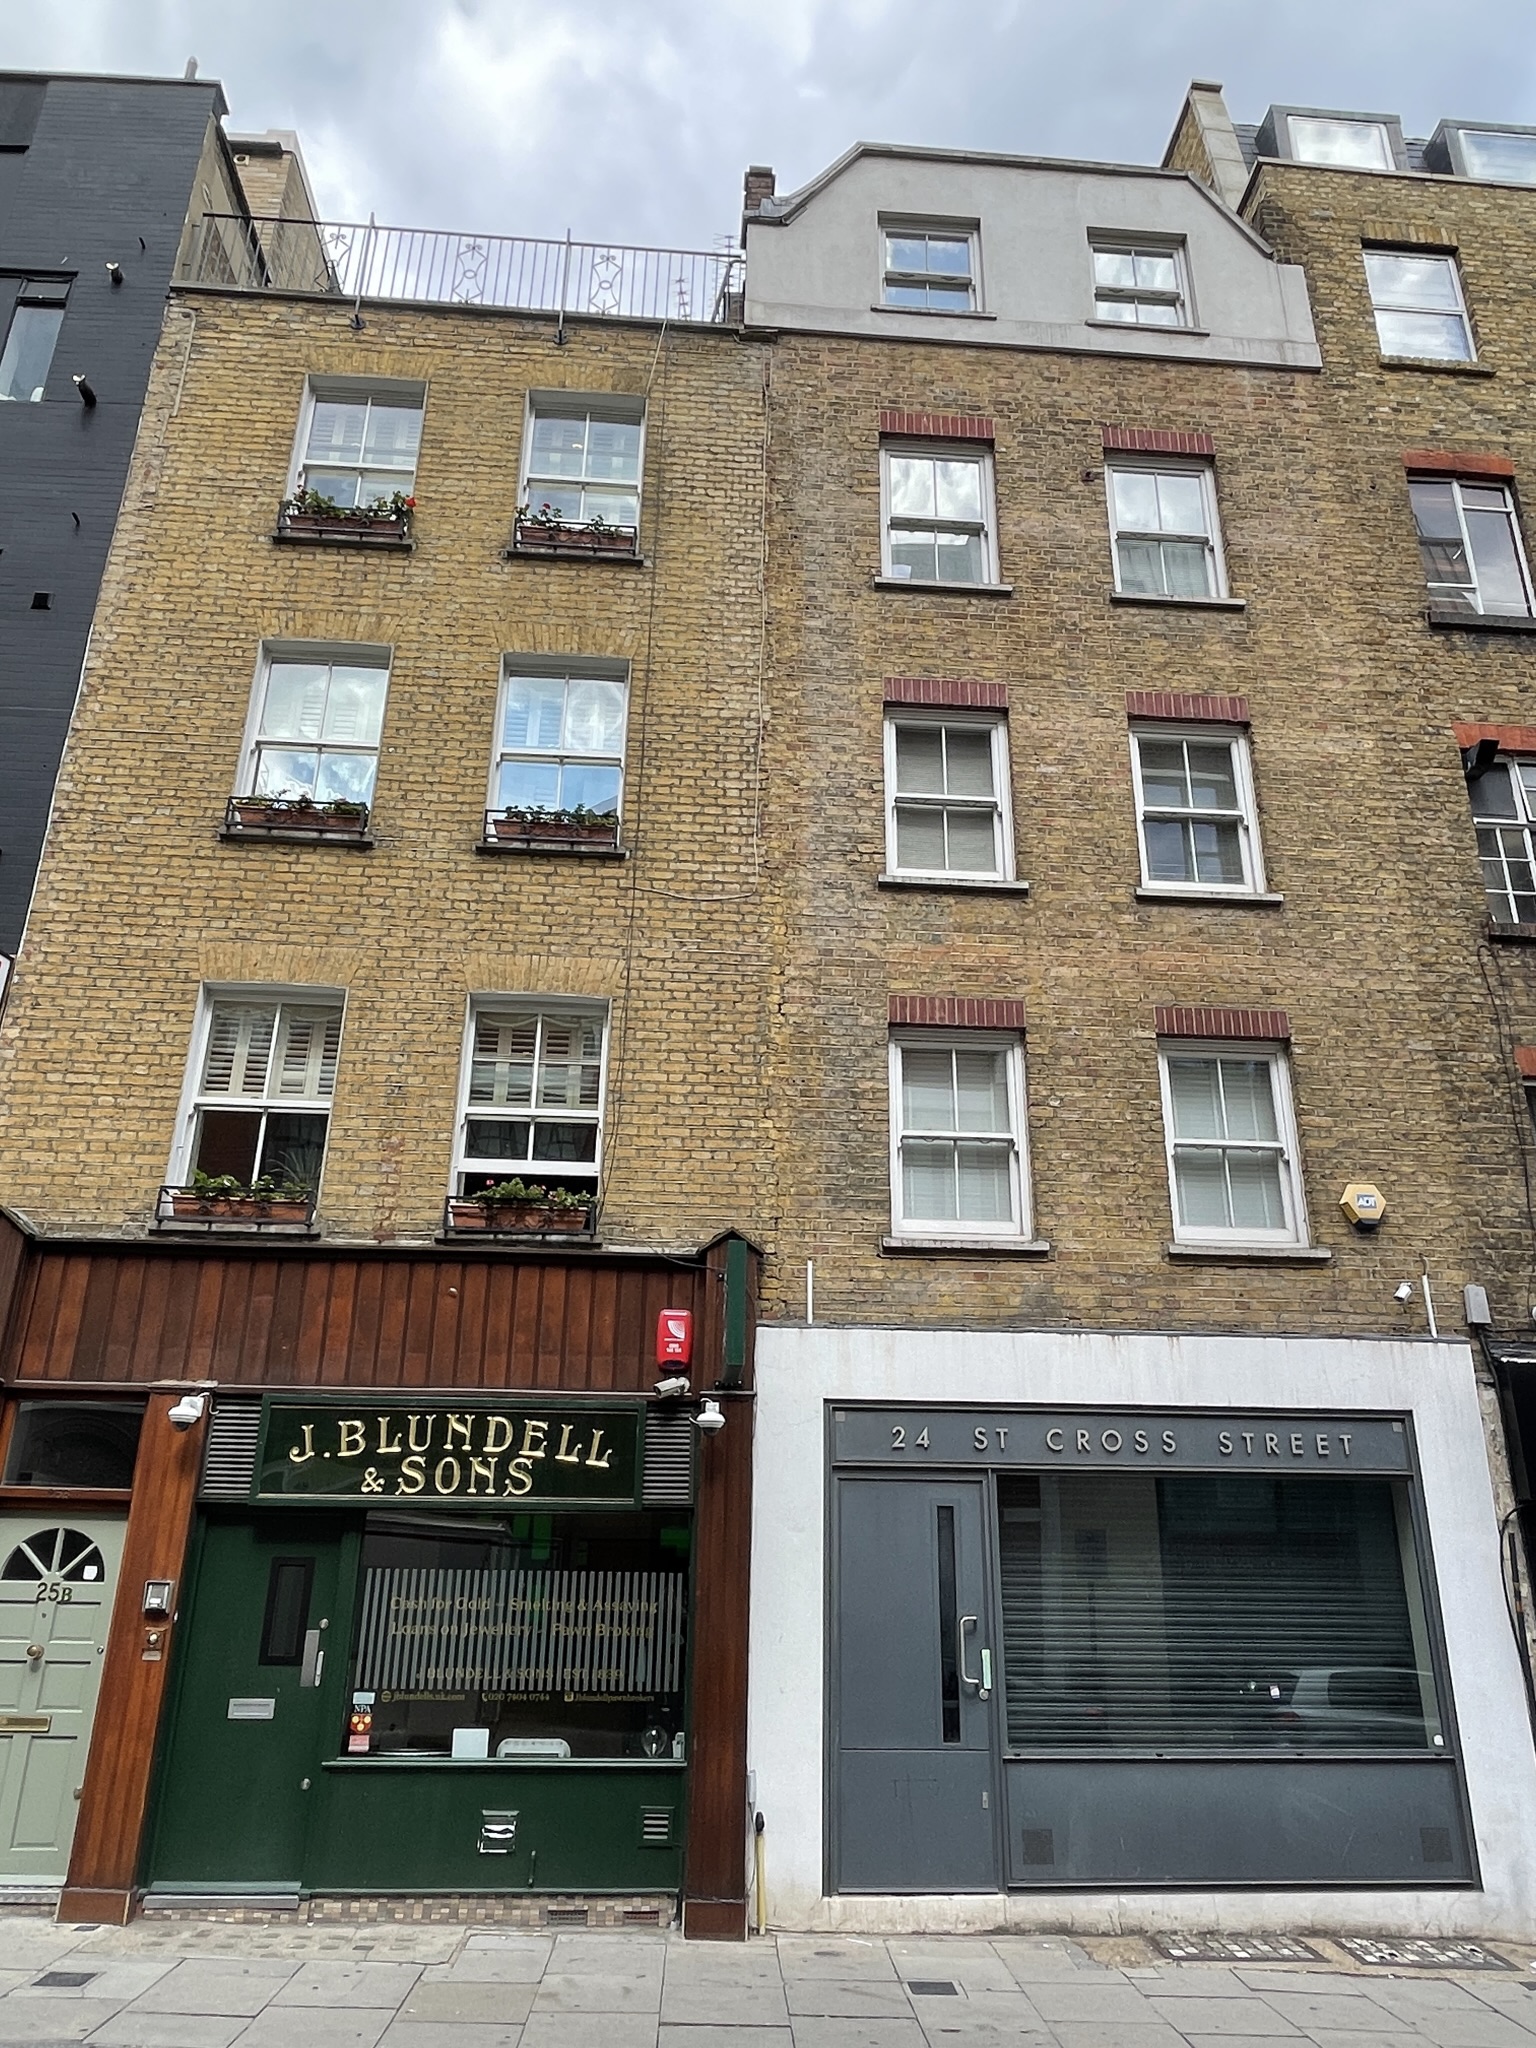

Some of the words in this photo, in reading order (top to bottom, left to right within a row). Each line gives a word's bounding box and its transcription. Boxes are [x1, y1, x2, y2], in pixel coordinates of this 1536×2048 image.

[1357, 1196, 1377, 1207] ADT
[890, 1426, 931, 1449] 24
[974, 1427, 1009, 1450] ST
[1046, 1429, 1178, 1453] CROSS
[1218, 1431, 1354, 1456] STREET
[361, 1467, 385, 1493] &
[395, 1455, 533, 1497] SONS
[36, 1582, 72, 1602] 25B
[390, 1597, 427, 1611] Cash
[431, 1597, 452, 1611] for
[456, 1597, 491, 1611] Gold
[509, 1597, 573, 1613] Smelting
[577, 1599, 588, 1612] &
[592, 1599, 659, 1615] Assaying
[391, 1621, 436, 1636] Loans
[440, 1625, 458, 1636] on
[461, 1622, 532, 1638] Jewellery
[552, 1623, 592, 1637] Pawn
[595, 1623, 654, 1639] Broking
[427, 1667, 502, 1680] BLUNDELL
[516, 1668, 554, 1680] SONS
[354, 1704, 371, 1713] NPA
